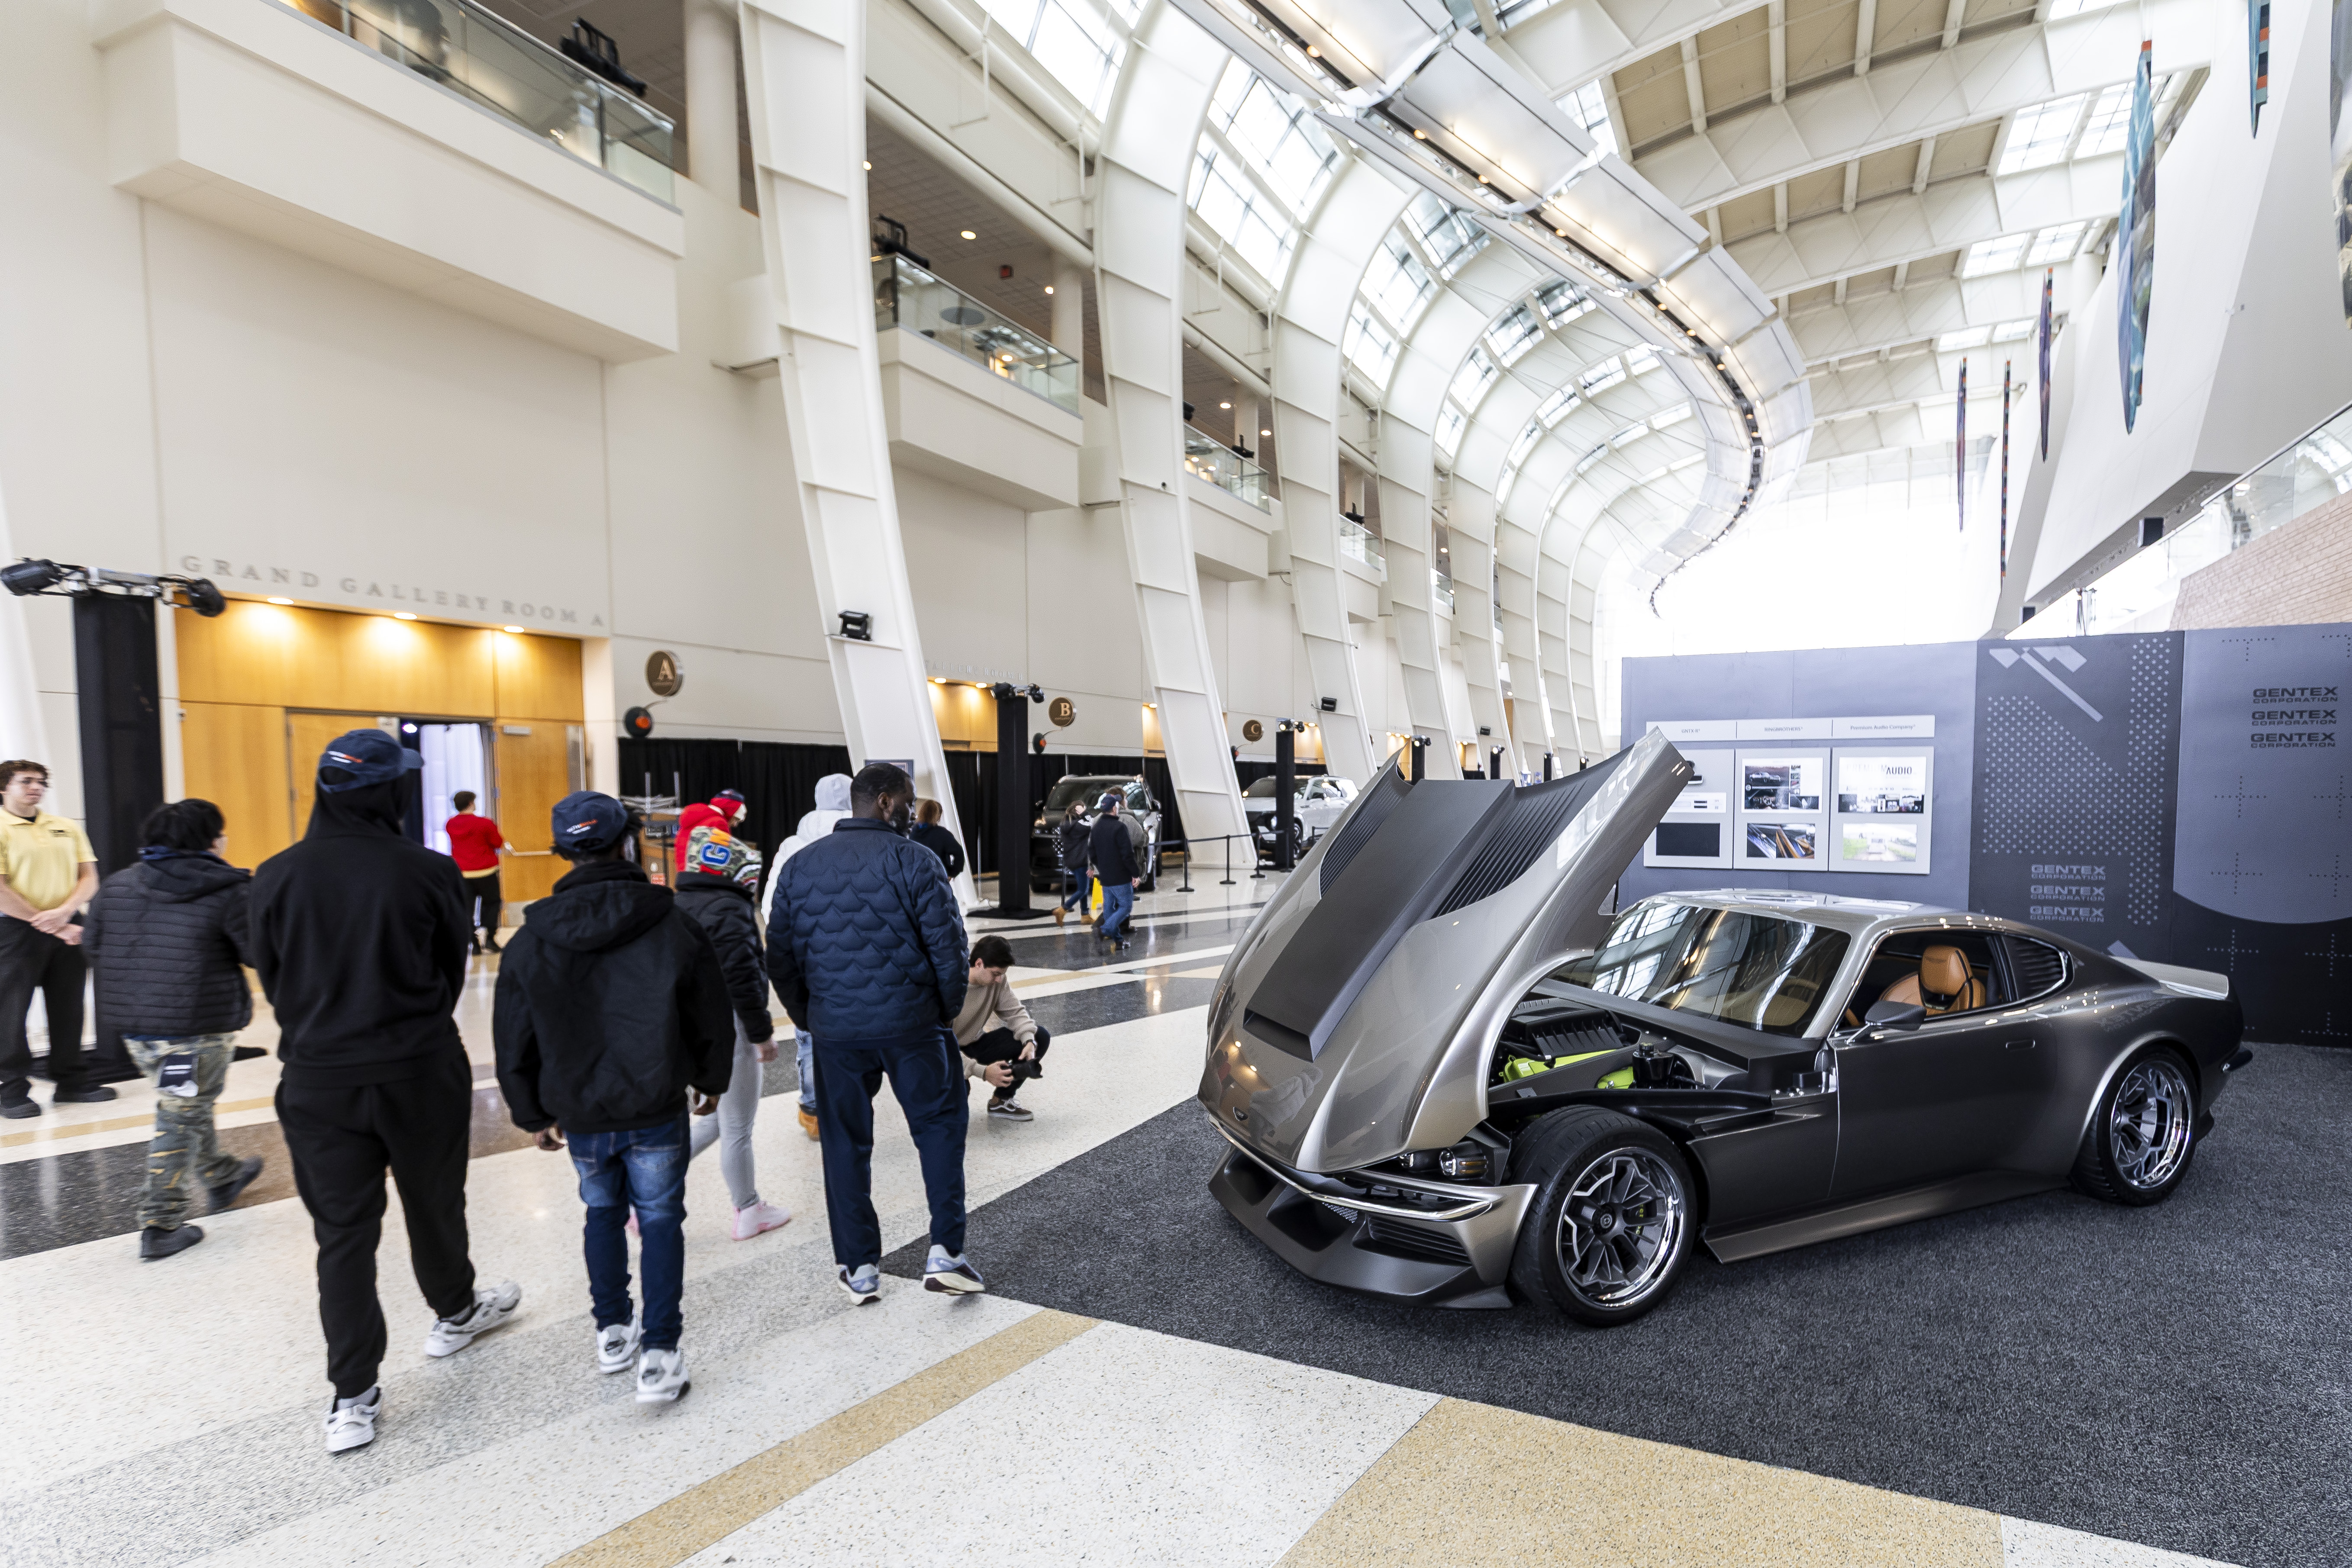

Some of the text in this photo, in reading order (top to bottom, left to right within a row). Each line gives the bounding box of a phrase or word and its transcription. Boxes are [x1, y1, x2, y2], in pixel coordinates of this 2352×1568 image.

[181, 555, 604, 626] GRAND GALLERY ROOM A
[657, 658, 674, 681] A
[2252, 686, 2338, 697] GENTEX
[1060, 702, 1071, 717] B
[2252, 709, 2337, 720] GENTEX
[1251, 723, 1259, 734] C
[2251, 732, 2336, 742] GENTEX
[1886, 766, 1912, 775] AUDIO
[2031, 864, 2106, 874] GENTEX
[2030, 885, 2105, 895] GENTEX
[2030, 906, 2104, 916] GENTEX
